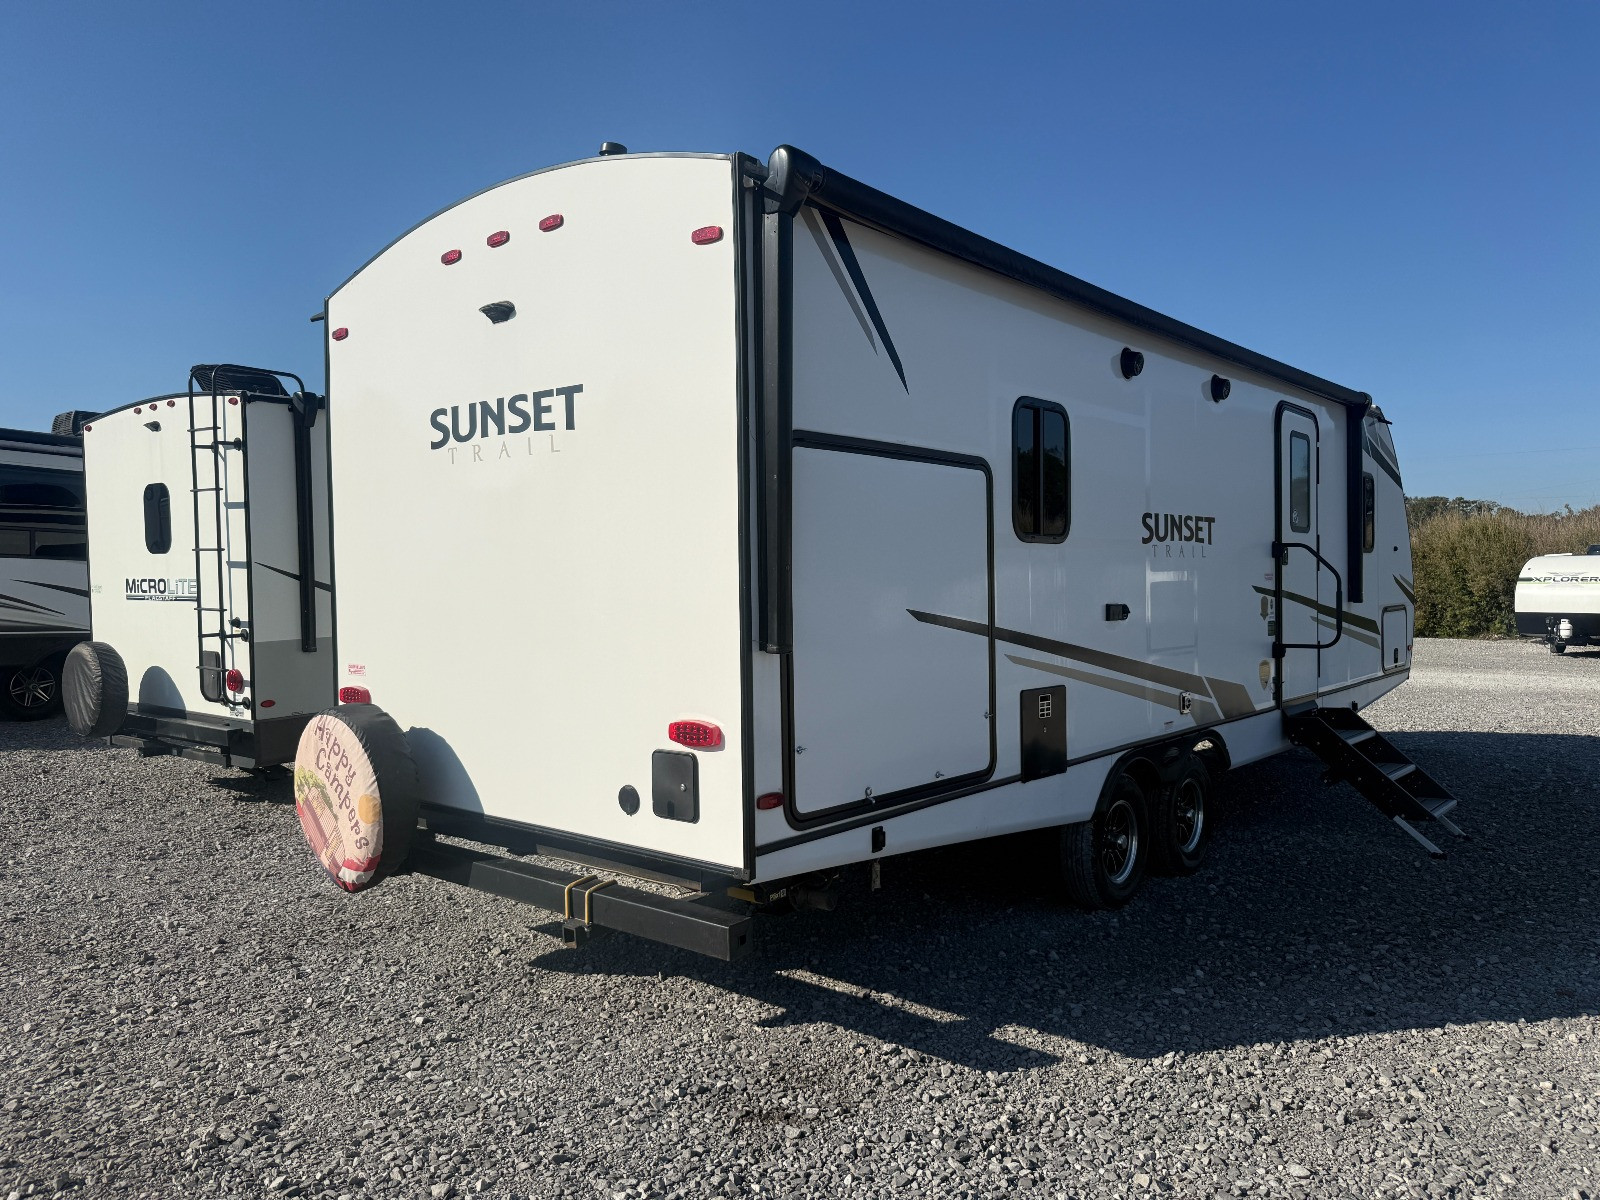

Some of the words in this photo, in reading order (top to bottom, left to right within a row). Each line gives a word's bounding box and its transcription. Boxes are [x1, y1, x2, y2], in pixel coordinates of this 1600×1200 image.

[430, 384, 584, 450] SUNSET
[448, 434, 561, 465] TRAIL
[1141, 512, 1216, 545] SUNSET
[1151, 544, 1207, 559] TRAIL
[314, 716, 357, 787] Happy
[316, 747, 369, 850] Campers
